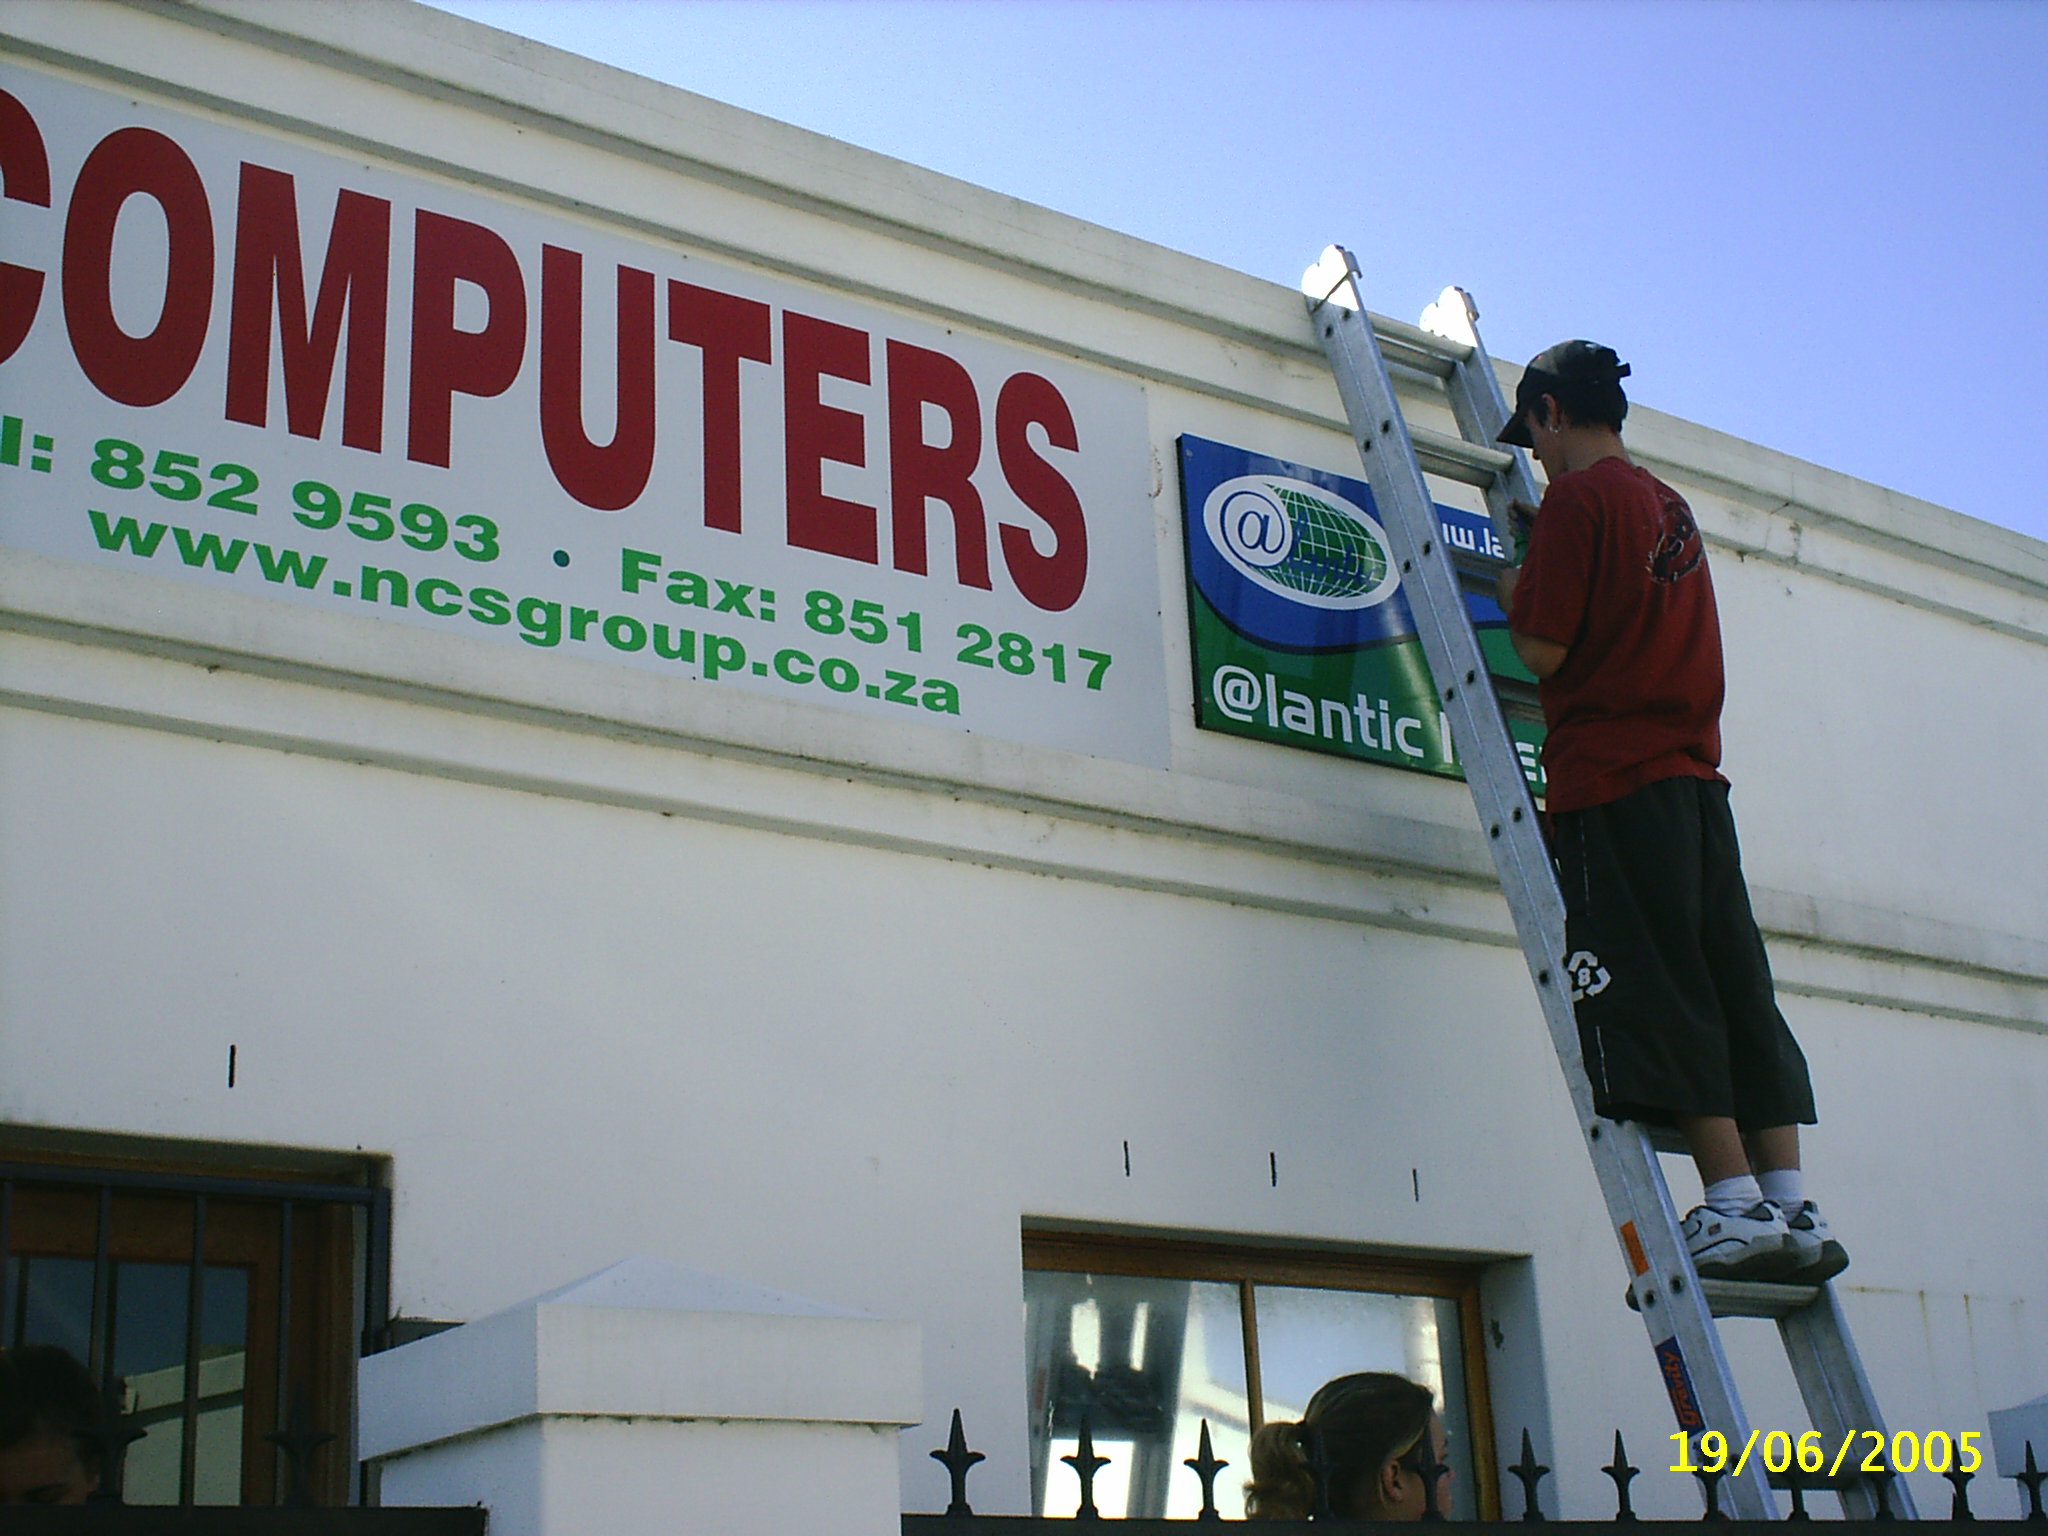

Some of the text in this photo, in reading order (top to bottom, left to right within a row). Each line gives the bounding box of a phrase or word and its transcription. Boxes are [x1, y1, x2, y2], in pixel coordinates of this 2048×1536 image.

[88, 509, 961, 715] www.ncsgroup.co.za
[90, 438, 260, 515] 852
[292, 480, 501, 562] 9593
[621, 547, 776, 623] Fax:
[803, 589, 923, 653] 851
[956, 622, 1113, 691] 2817
[1212, 664, 1425, 758] @lantic
